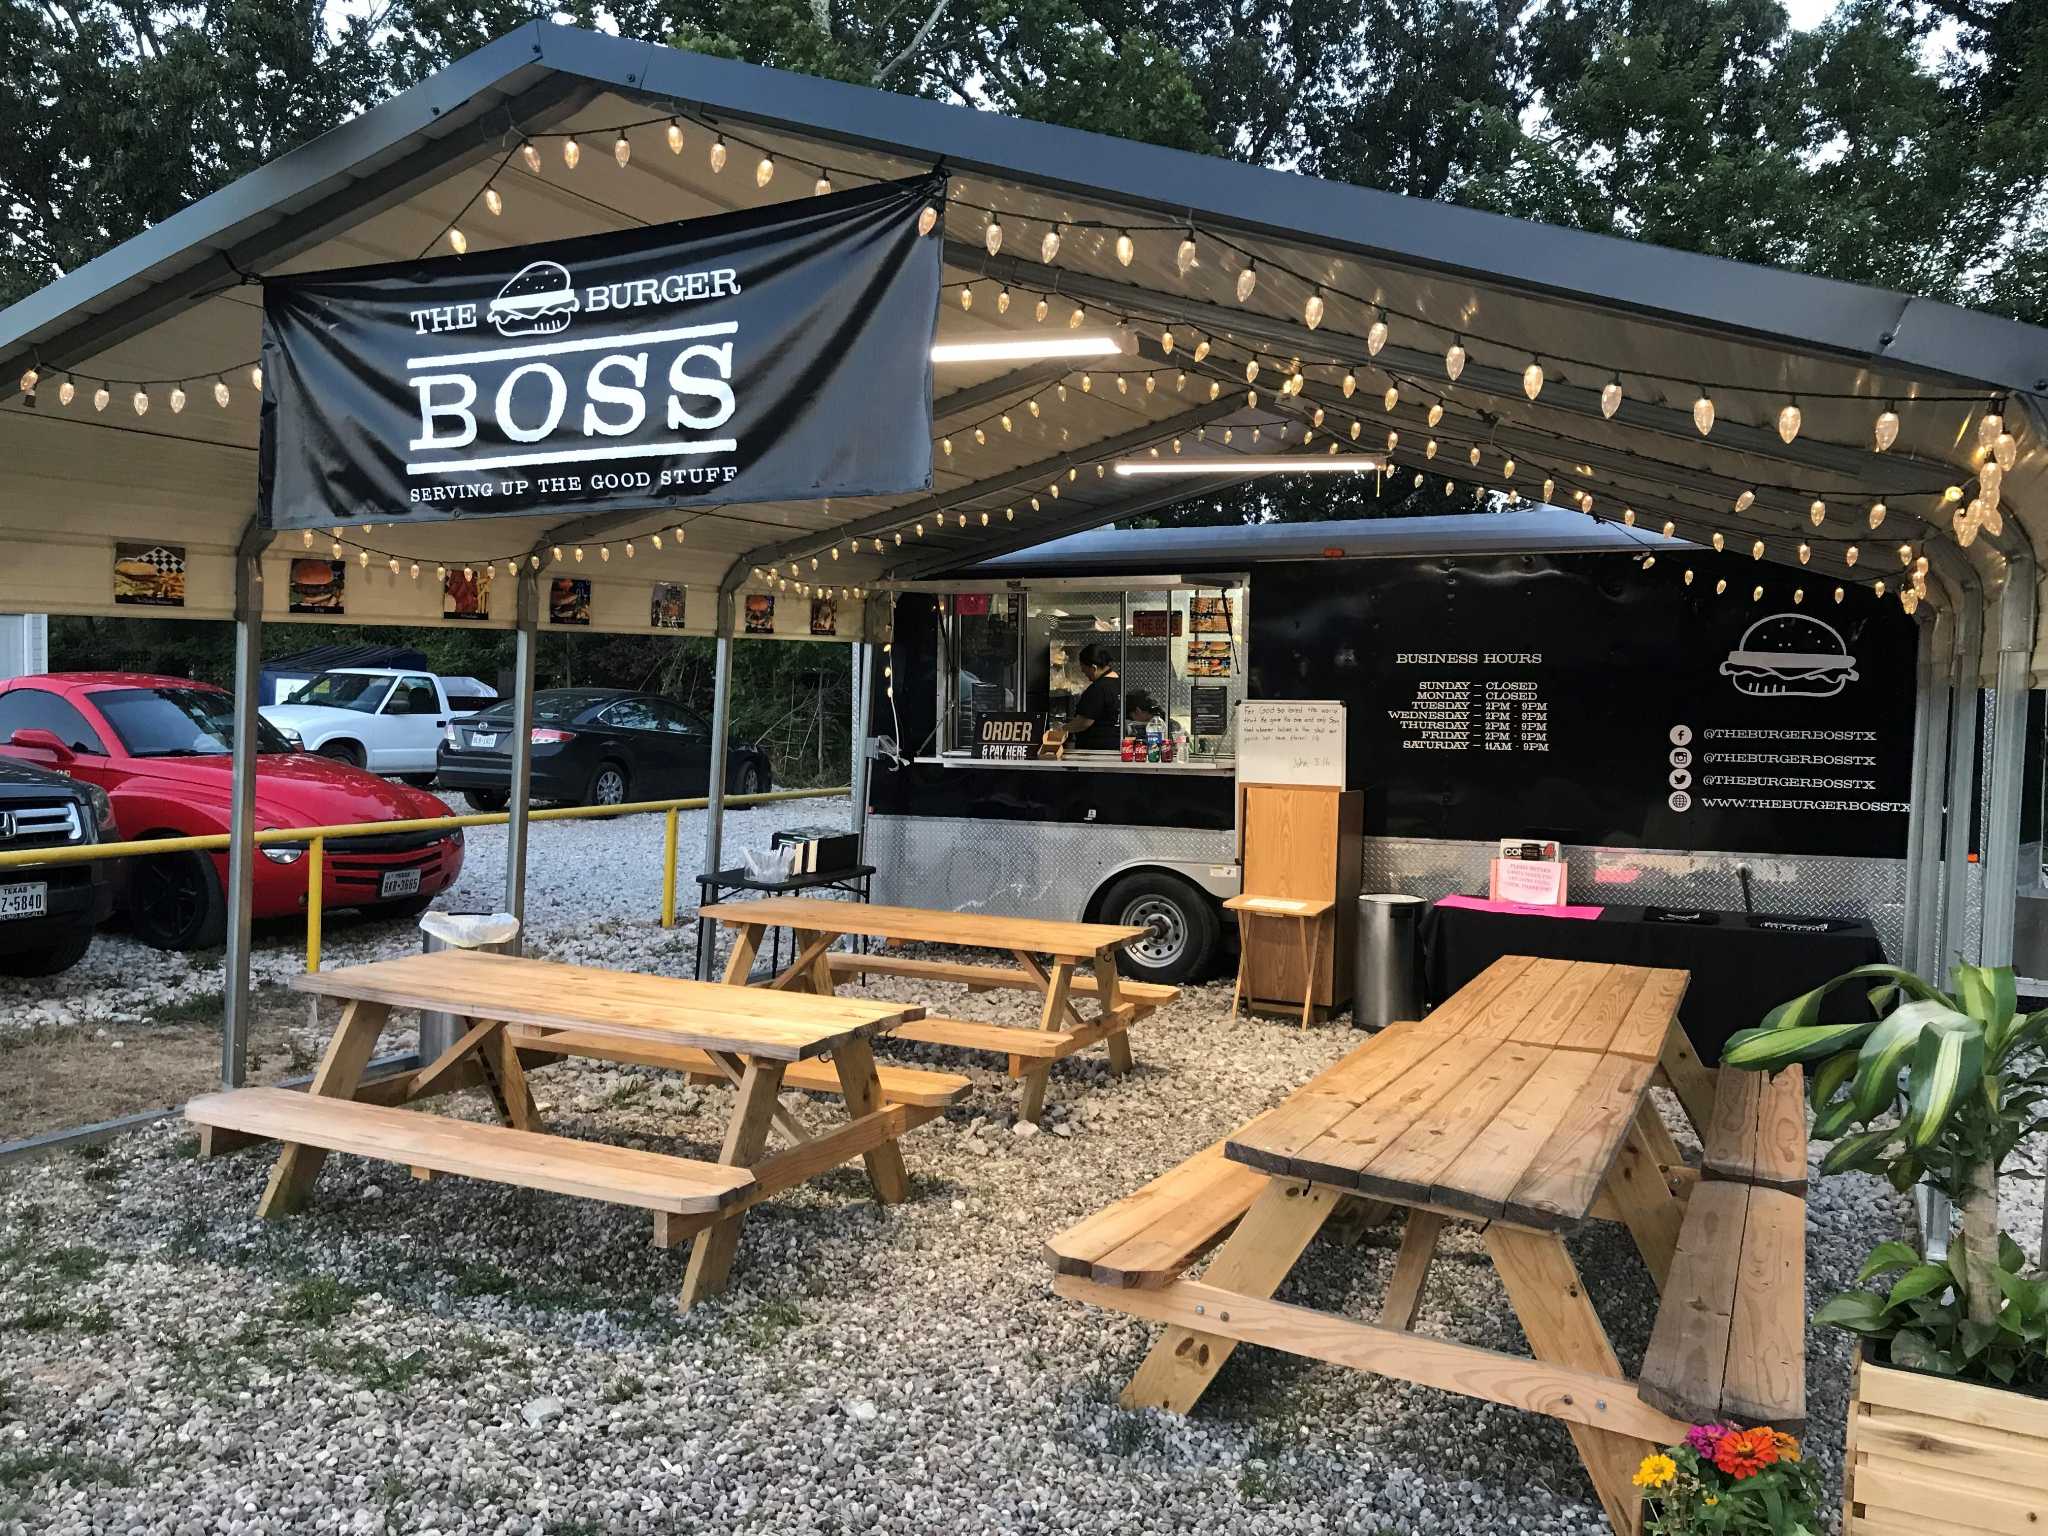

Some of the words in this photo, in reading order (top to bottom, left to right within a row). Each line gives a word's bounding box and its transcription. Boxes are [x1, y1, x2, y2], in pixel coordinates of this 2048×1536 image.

[410, 304, 477, 335] THE
[585, 268, 742, 312] BURGER
[408, 341, 738, 452] BOSS
[410, 482, 493, 502] SERVING
[502, 481, 528, 496] UP
[538, 476, 582, 493] THE
[591, 471, 650, 489] GOOD
[660, 465, 738, 486] STUFF
[1395, 653, 1478, 664] BUSINESS
[1483, 653, 1542, 664] HOURS
[1419, 682, 1471, 690] SUNDAY
[1485, 682, 1538, 690] CLOSED
[1416, 691, 1471, 699] MONDAY
[1485, 692, 1538, 700] CLOSED
[1411, 701, 1471, 709] TUESDAY
[1485, 702, 1511, 711] 2PM
[1521, 702, 1548, 711] 9PM
[1387, 711, 1470, 719] WEDNESDAY
[1485, 712, 1511, 720] 2PM
[1521, 712, 1548, 721] 9PM
[982, 721, 1033, 742] ORDER
[1400, 721, 1470, 729] THURSDAY
[1485, 722, 1511, 730] 2PM
[1521, 722, 1548, 731] 9PM
[1422, 731, 1470, 739] FRIDAY
[1485, 732, 1511, 740] 2PM
[1521, 732, 1547, 741] 9PM
[1703, 729, 1877, 741] @THEBURGERBOSSTX
[989, 745, 1006, 757] PAY
[1006, 745, 1028, 757] HERE
[1403, 741, 1470, 749] SATURDAY
[1485, 742, 1512, 750] 11AM
[1523, 742, 1549, 751] 9PM
[1703, 753, 1877, 766] @THEBURGERBOSSTX
[1703, 775, 1876, 790] @THEBURGERBOSSTX
[4, 887, 28, 895] TEXAS
